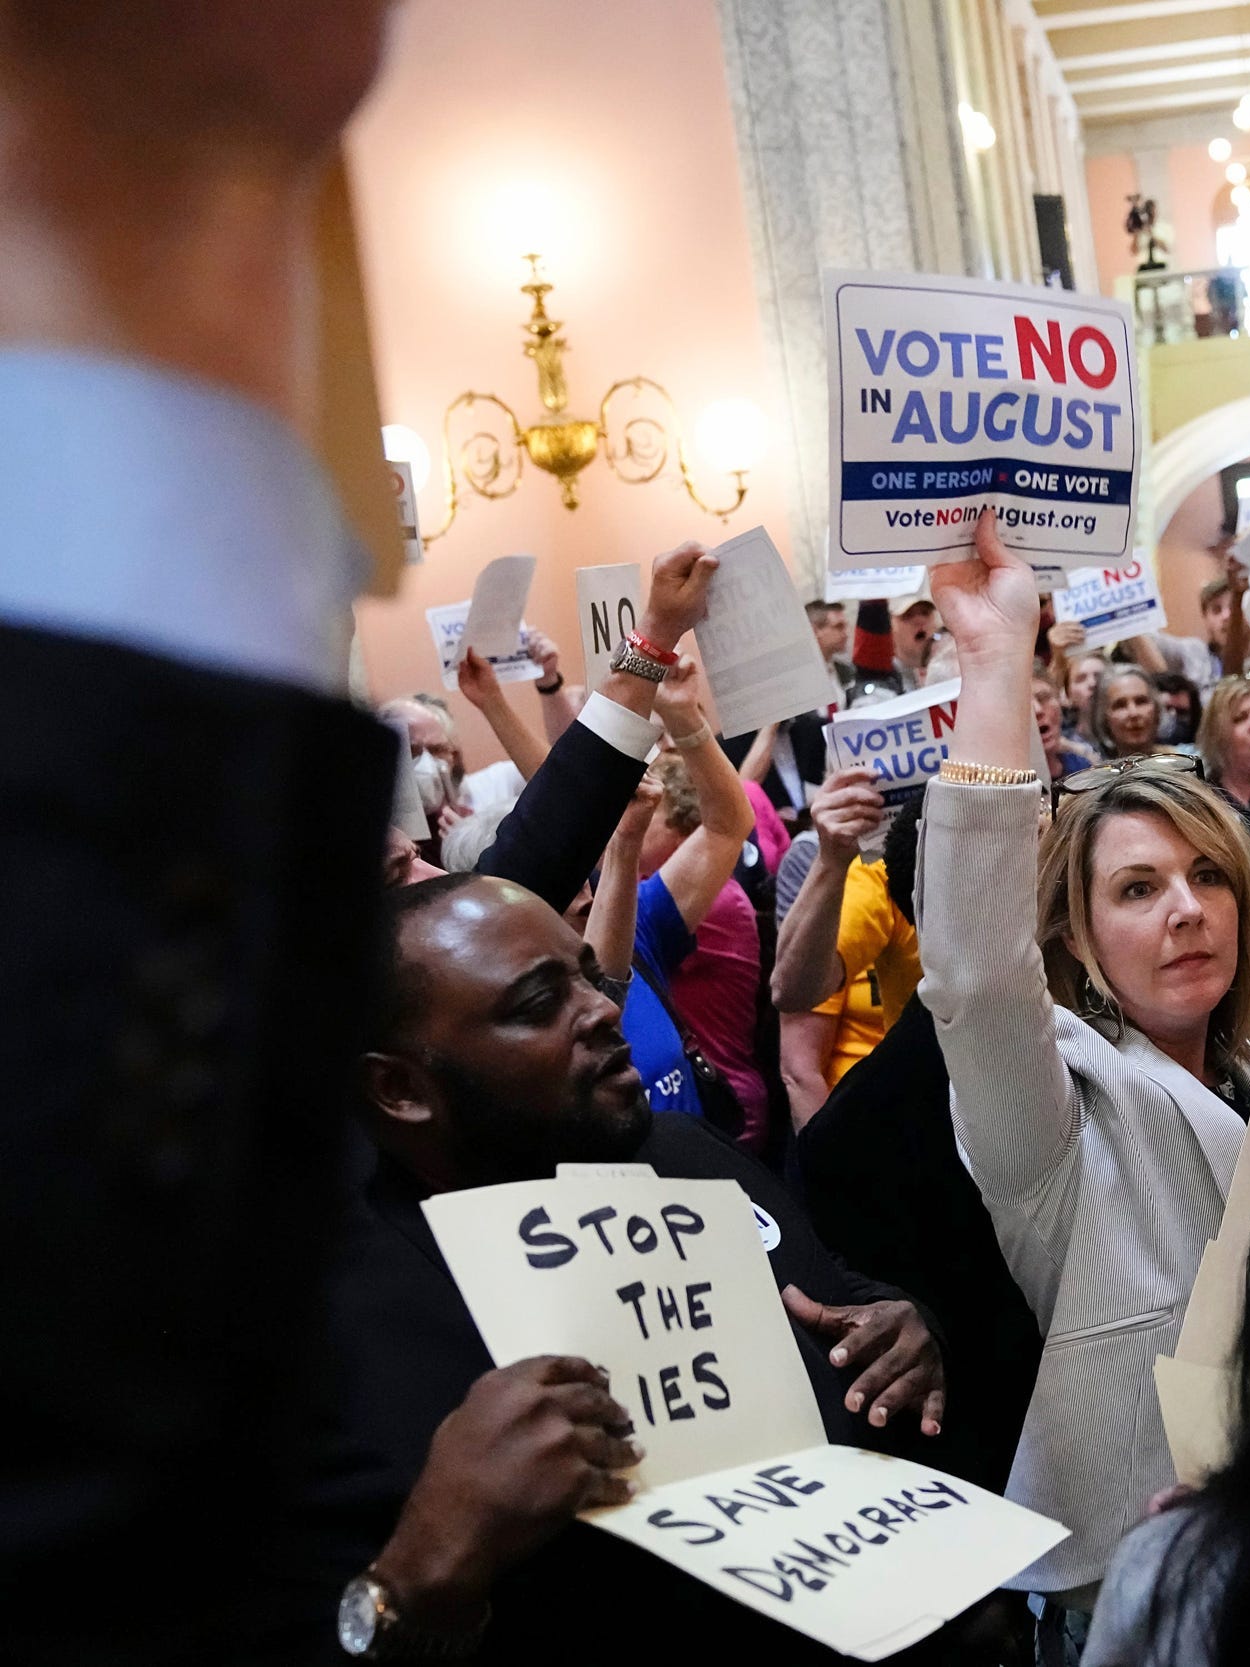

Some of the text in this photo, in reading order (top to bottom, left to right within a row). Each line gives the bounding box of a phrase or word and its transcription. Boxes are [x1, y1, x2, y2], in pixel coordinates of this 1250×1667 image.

[856, 315, 1117, 390] VOTE NO
[861, 389, 1121, 452] IN AUGUST
[872, 472, 916, 490] ONE
[923, 468, 993, 489] PERSON
[1014, 470, 1059, 492] ONE
[1065, 474, 1110, 496] VOTE
[591, 597, 636, 655] NO
[1073, 580, 1147, 616] AUGUST
[842, 700, 958, 757] VOTE N
[519, 1204, 705, 1268] STOP
[617, 1281, 712, 1339] THE
[647, 1465, 825, 1546] SAVE
[723, 1481, 969, 1602] DEMOCRACY
